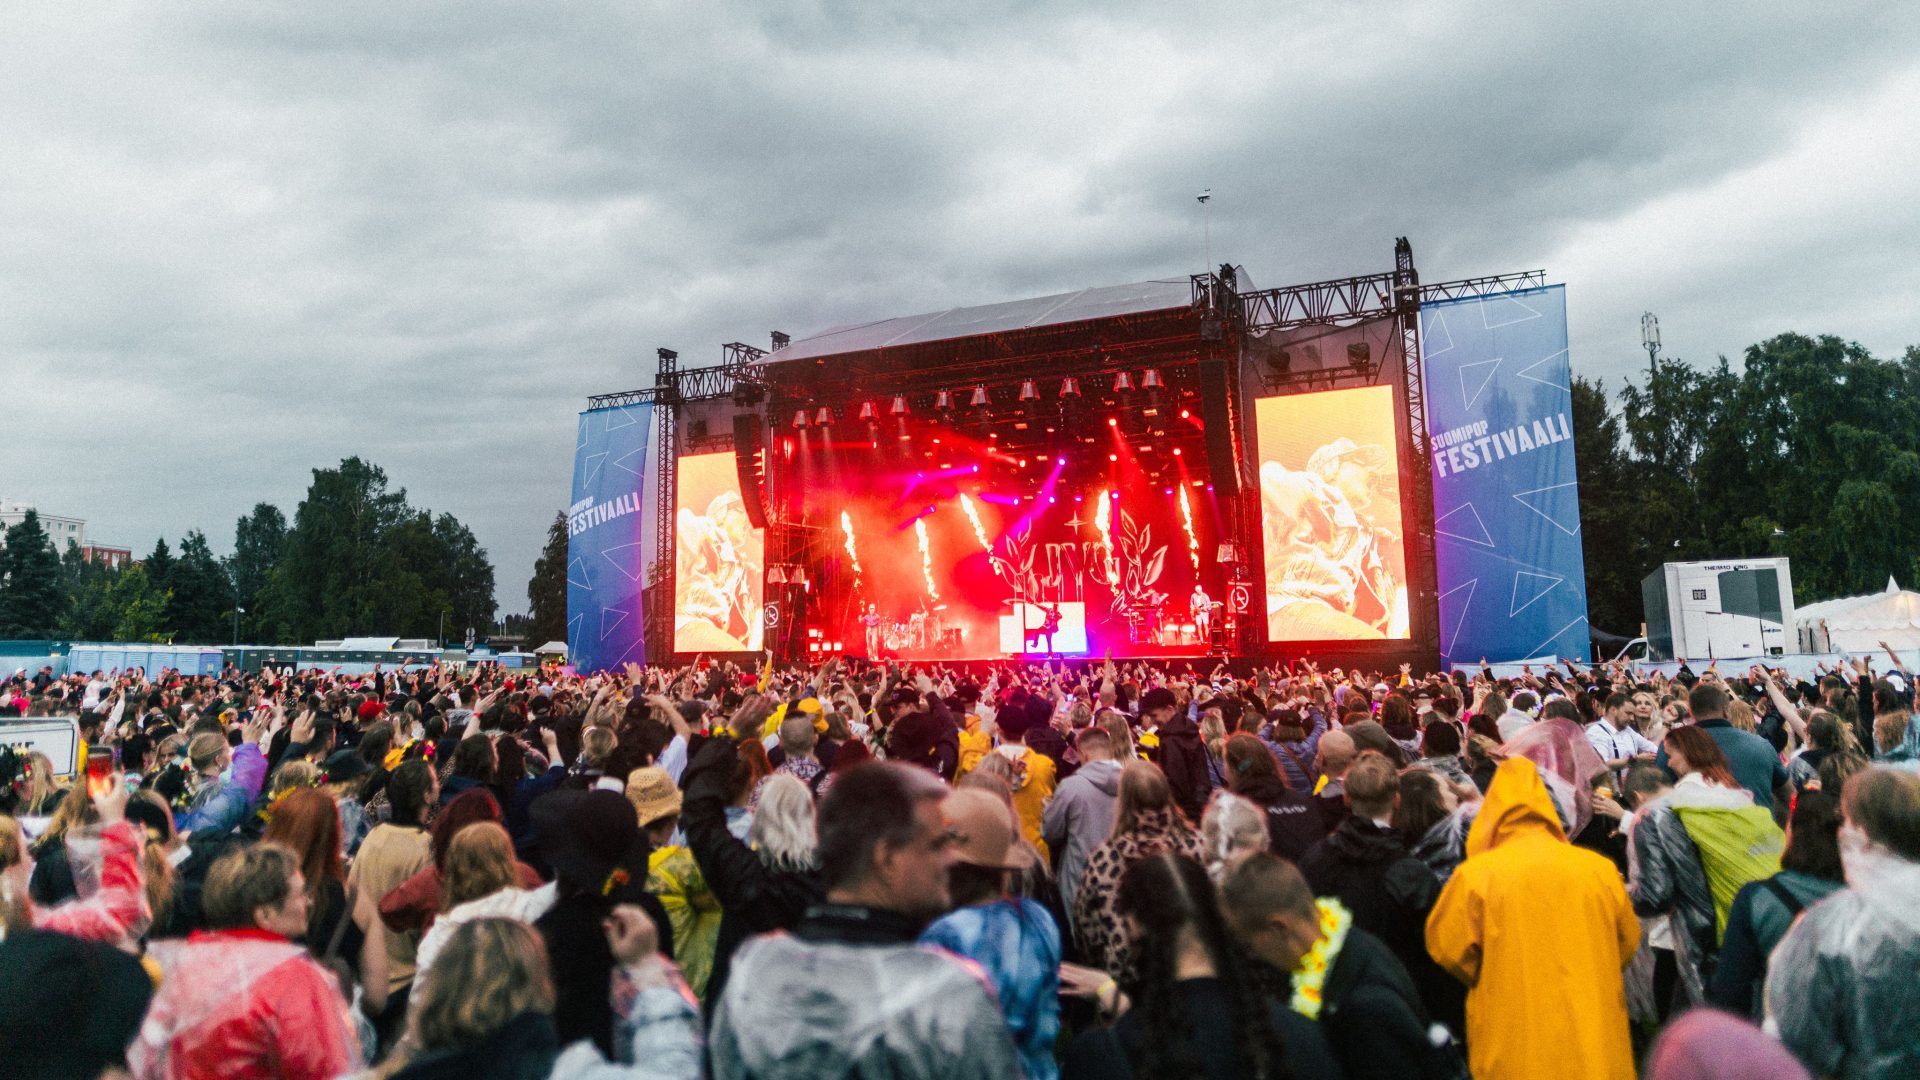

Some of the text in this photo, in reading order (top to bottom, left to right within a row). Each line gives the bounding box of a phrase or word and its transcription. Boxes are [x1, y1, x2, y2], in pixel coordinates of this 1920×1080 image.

[1431, 420, 1488, 451] SUOMIPOP
[1434, 413, 1570, 478] FESTIVAALI
[568, 492, 640, 539] FESTIVAALI
